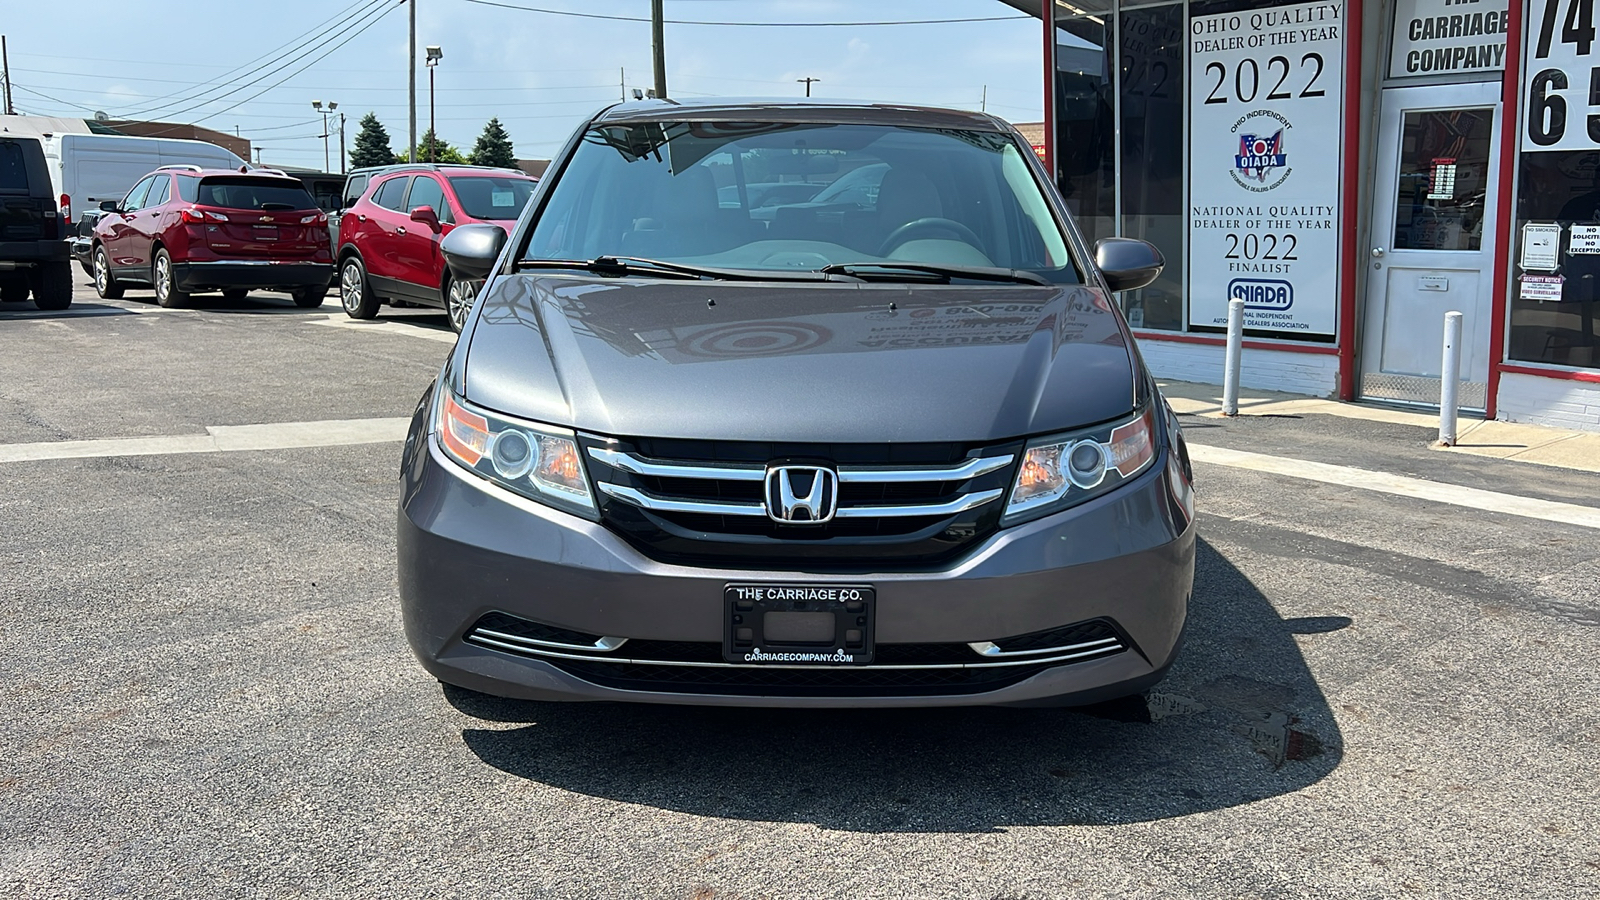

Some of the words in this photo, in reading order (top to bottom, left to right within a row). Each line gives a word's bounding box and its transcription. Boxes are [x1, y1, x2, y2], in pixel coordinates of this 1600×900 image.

[1193, 17, 1241, 35] OHIO
[1251, 4, 1341, 31] QUALITY
[1408, 10, 1509, 42] CARRIAGE
[1195, 37, 1245, 53] DEALER
[1248, 34, 1266, 48] OF
[1269, 31, 1297, 46] THE
[1300, 27, 1339, 43] YEAR
[1406, 43, 1507, 73] COMPANY
[1204, 52, 1326, 105] 2022
[1230, 116, 1247, 134] OHIO
[1246, 109, 1293, 131] INDEPENDENT
[1241, 155, 1278, 168] OIADA
[1229, 169, 1250, 191] AUTOMOBILE
[1269, 167, 1293, 190] ASSOCIATION
[1193, 206, 1263, 216] NATIONAL
[1269, 206, 1334, 218] QUALITY
[1194, 219, 1241, 229] DEALER
[1246, 219, 1262, 229] OF
[1267, 219, 1292, 229] THE
[1298, 219, 1332, 229] YEAR
[1224, 233, 1298, 261] 2022
[1229, 262, 1291, 273] FINALIST
[1271, 321, 1310, 329] ASSOCIATION
[737, 588, 764, 600] THE
[767, 588, 836, 601] CARRIAGE
[839, 589, 863, 602] CO.
[744, 652, 854, 663] CARRIAGECOMPANY.COM
